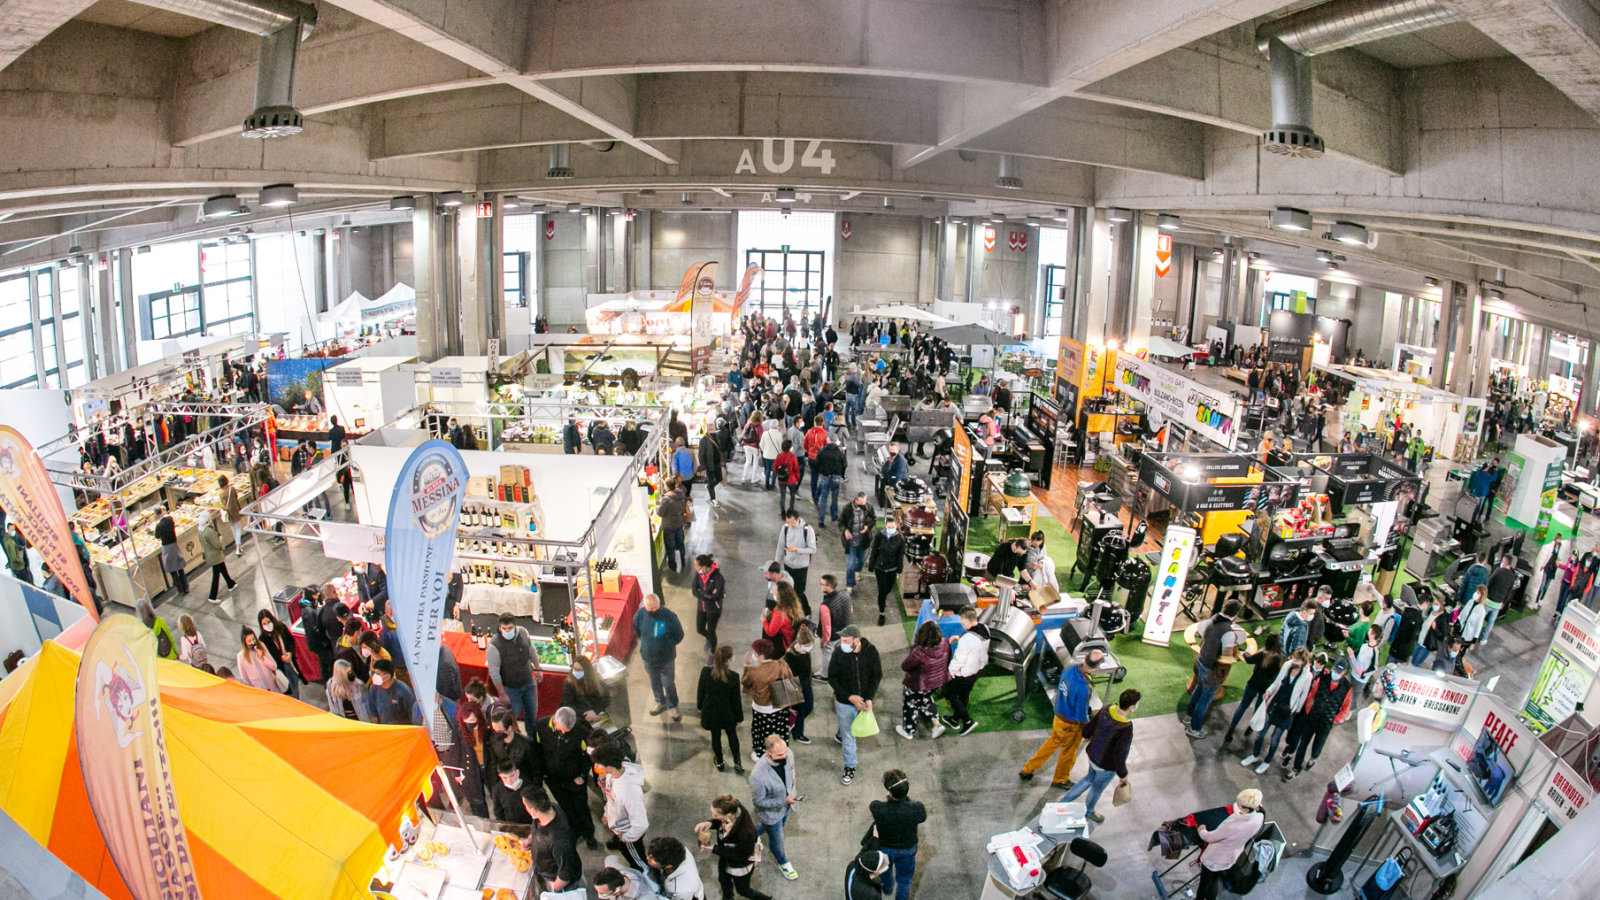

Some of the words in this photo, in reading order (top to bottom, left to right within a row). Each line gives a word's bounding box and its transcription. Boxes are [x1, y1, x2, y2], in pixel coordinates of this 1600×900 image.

[489, 339, 498, 373] NORCIA
[1174, 378, 1185, 389] GAS
[412, 477, 460, 514] MESSINA
[420, 544, 434, 599] PASSIONE
[431, 570, 444, 603] VOI
[414, 601, 425, 650] NOSTRA
[427, 608, 439, 641] PER
[413, 651, 421, 665] LA
[1399, 679, 1440, 698] OBERHOFER
[1440, 689, 1468, 705] ARNOLD
[1423, 699, 1461, 715] BRESSANONE
[1481, 710, 1518, 756] PFAFF
[1547, 786, 1565, 809] BRIXEN
[1552, 771, 1584, 809] OBERHOFER
